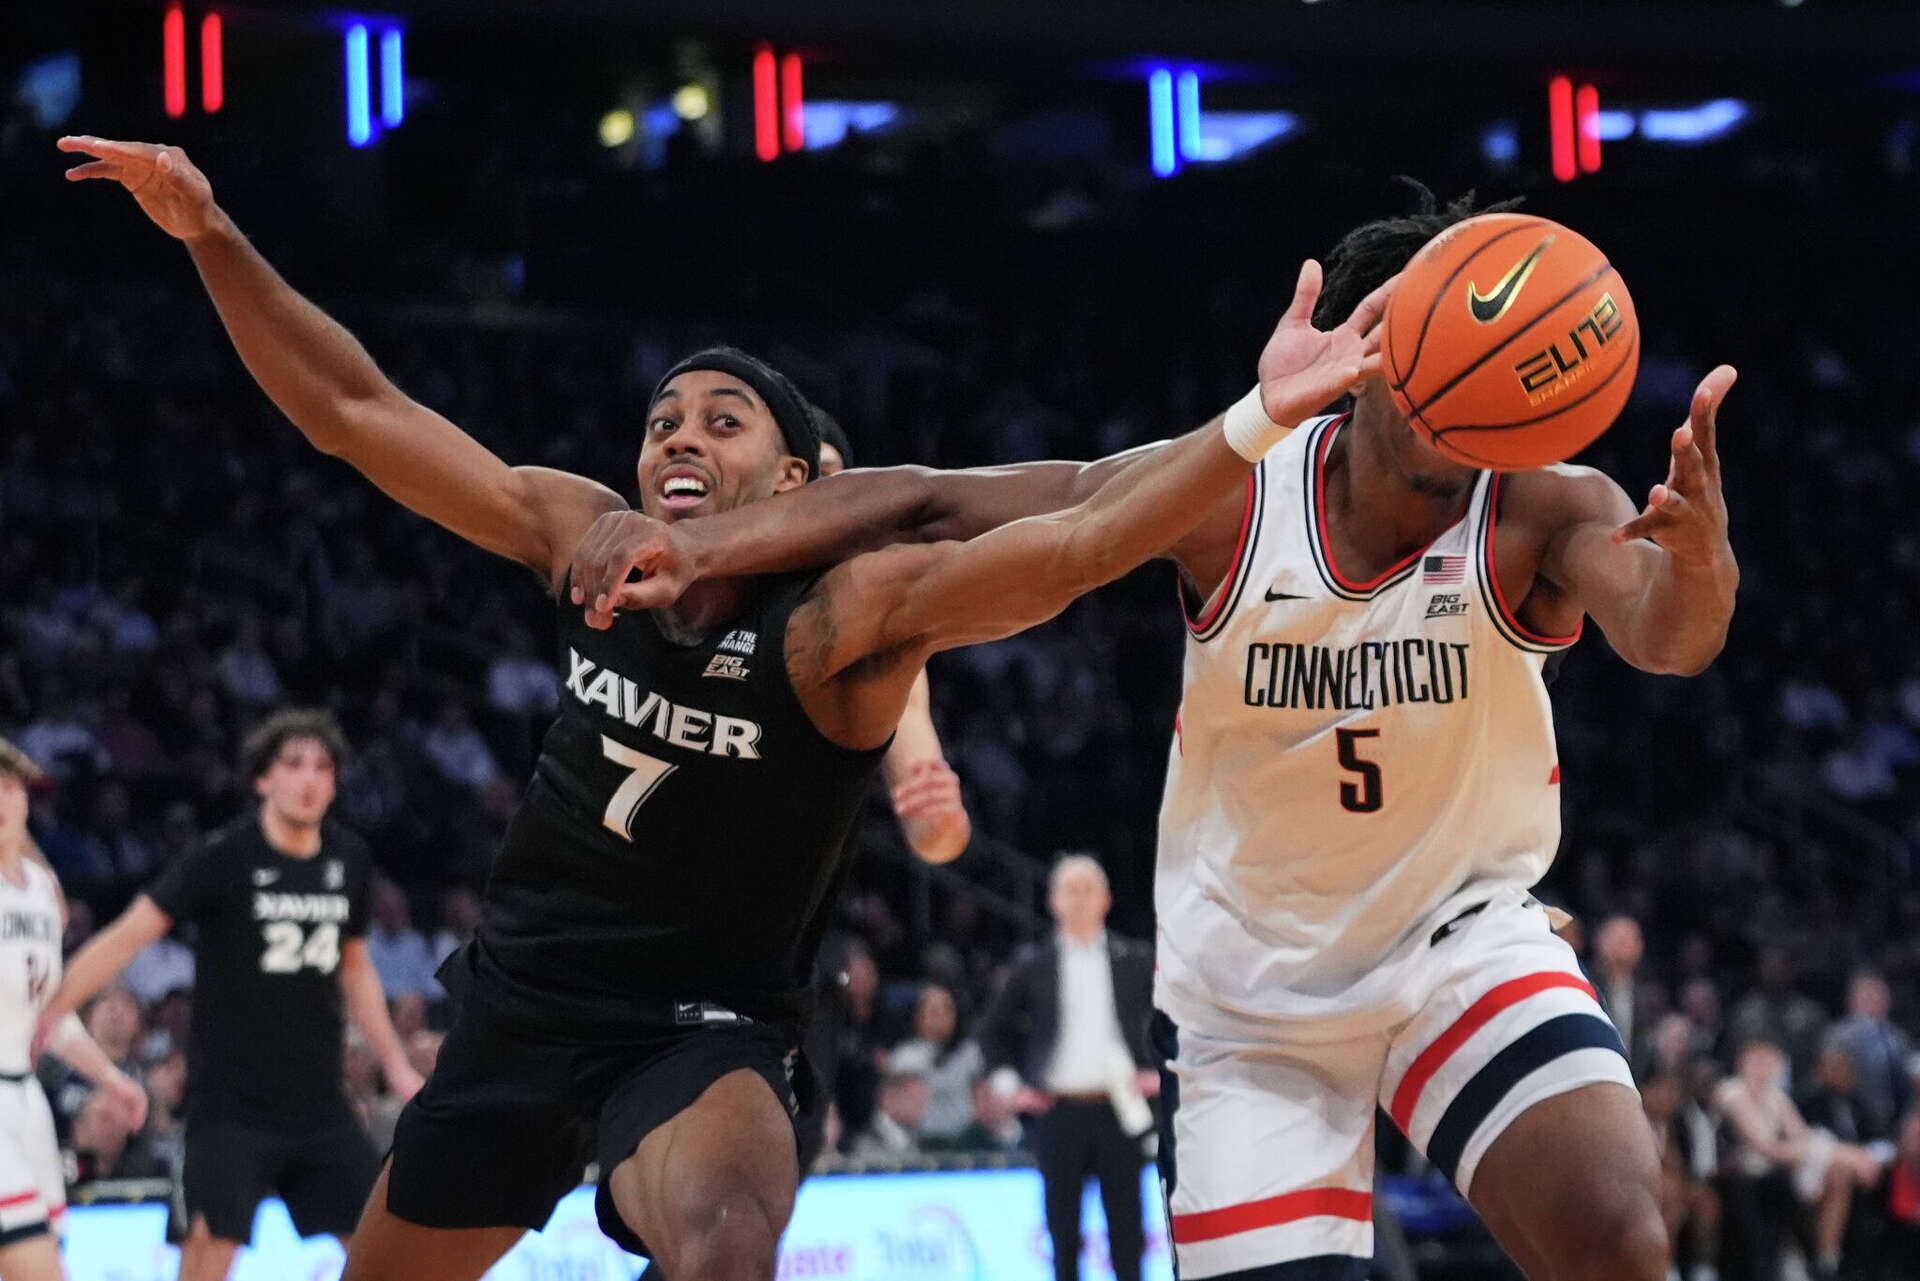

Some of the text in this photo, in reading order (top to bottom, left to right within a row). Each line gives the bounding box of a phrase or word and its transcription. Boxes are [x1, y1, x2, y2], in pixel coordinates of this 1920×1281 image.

[1514, 292, 1623, 396] ELITE
[1427, 603, 1470, 614] EAST
[1431, 594, 1461, 604] BIG
[717, 639, 756, 655] HANGE
[738, 630, 758, 643] THE
[704, 662, 750, 677] EAST
[711, 654, 745, 667] BIG
[1245, 638, 1469, 711] CONNECTICUT
[565, 646, 762, 759] XAVIER
[1336, 727, 1384, 814] 5
[600, 733, 680, 843] 7
[262, 922, 341, 975] 24
